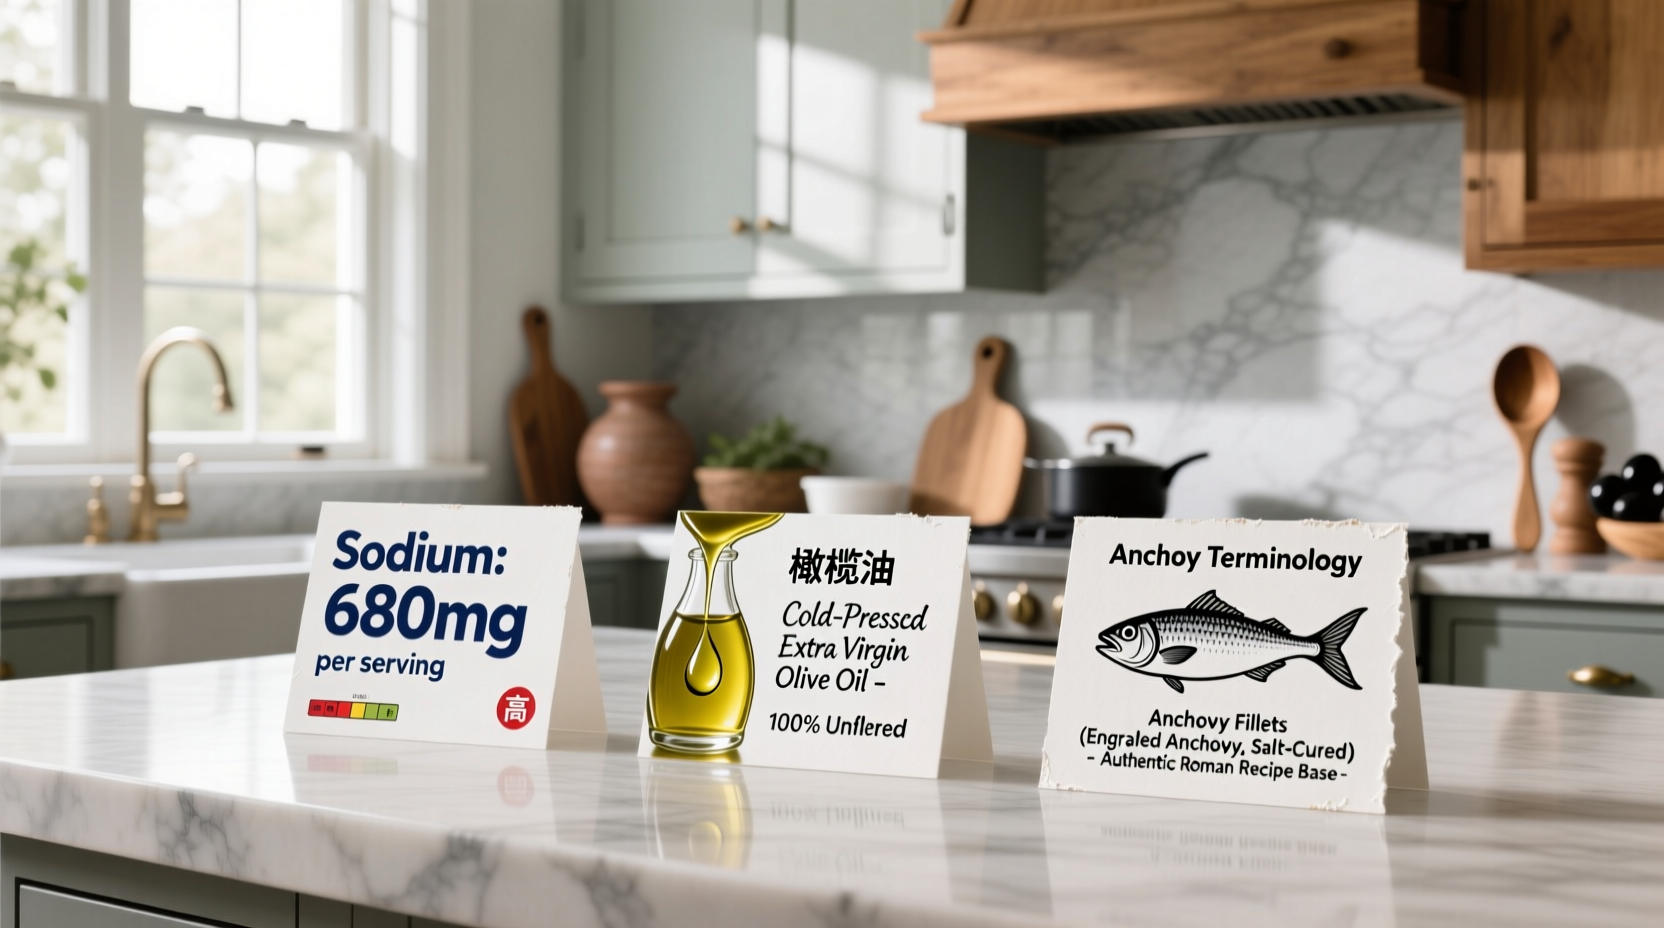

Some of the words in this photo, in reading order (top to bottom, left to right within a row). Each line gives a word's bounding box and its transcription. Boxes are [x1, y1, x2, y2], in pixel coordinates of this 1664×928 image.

[332, 530, 507, 575] Sodium:
[788, 547, 896, 586] 橄榄油
[1108, 543, 1201, 573] Anchoy
[1207, 546, 1363, 578] Terminology
[324, 583, 528, 659] 680mg
[315, 654, 356, 676] per
[360, 652, 446, 682] serving
[778, 633, 838, 660] Extra
[843, 636, 910, 669] Virgin
[775, 665, 831, 690] Olive
[836, 667, 869, 692] Oil
[504, 694, 530, 723] 高
[769, 712, 821, 734] 100%
[1148, 709, 1230, 734] Anchovy
[1235, 713, 1288, 733] Fillets
[1080, 726, 1161, 751] (Engraled
[1165, 733, 1245, 758] Anchovy,
[1251, 738, 1355, 764] Salt-Cured)
[1100, 751, 1176, 771] Authentic
[1180, 756, 1234, 774] Roman
[1239, 760, 1294, 781] Recipe
[1298, 763, 1337, 780] Base
